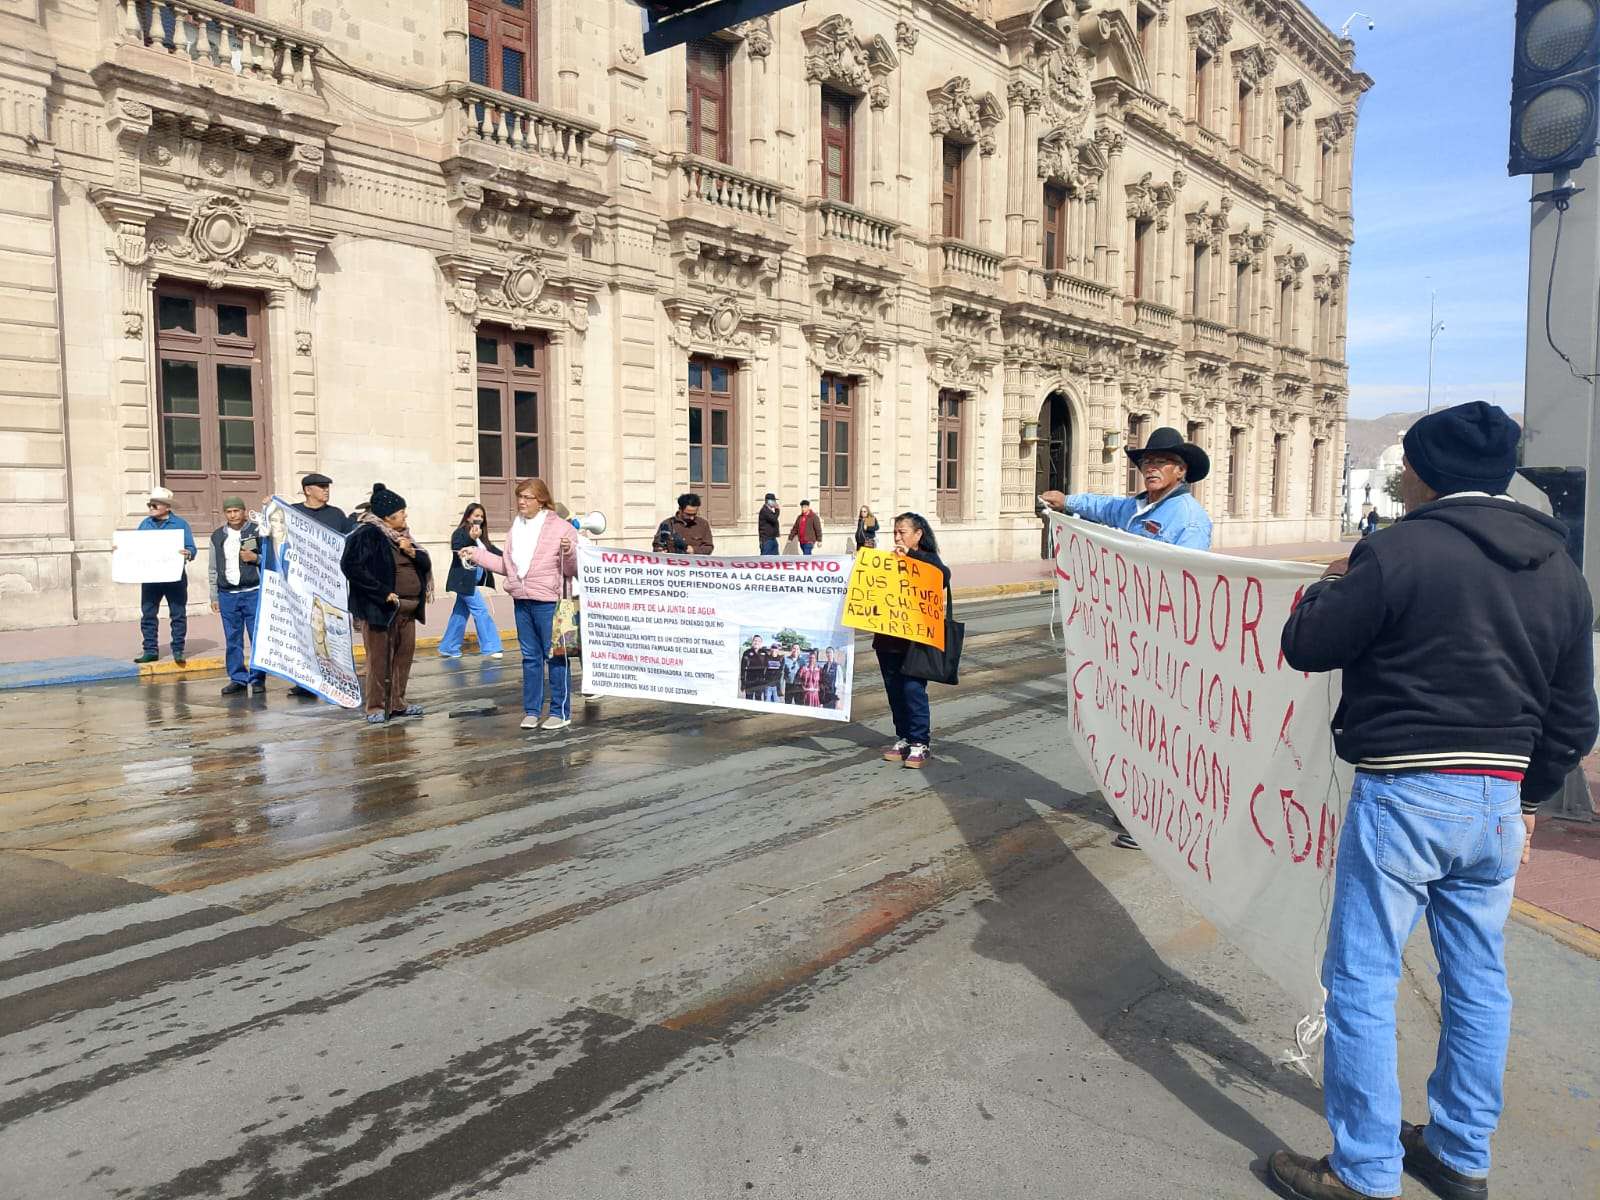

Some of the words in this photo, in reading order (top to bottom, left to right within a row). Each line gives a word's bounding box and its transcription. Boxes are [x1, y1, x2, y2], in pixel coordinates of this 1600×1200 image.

[286, 550, 298, 562] NO
[601, 552, 660, 565] MARU
[667, 557, 690, 566] ES
[696, 559, 724, 568] UN
[731, 560, 841, 572] GOBIERNO
[860, 551, 920, 578] LOERA
[583, 565, 602, 574] QUE
[604, 566, 622, 575] HOY
[625, 567, 643, 575] POR
[646, 568, 663, 576] HOY
[667, 569, 686, 577] NOS
[689, 570, 728, 579] PISOTEA
[755, 573, 786, 582] CLASE
[788, 575, 814, 583] BAJA
[856, 570, 887, 588] TUS
[584, 576, 600, 584] LOS
[603, 577, 665, 587] LADRILLEROS
[667, 580, 741, 591] QUERIENDONOS
[744, 583, 804, 593] ARREBATAR
[807, 587, 848, 595] NUESTRO
[584, 586, 626, 595] TERRENO
[629, 588, 689, 599] EMPESANDO:
[851, 587, 876, 602] DE
[602, 601, 630, 611] FALOMIR
[632, 602, 646, 612] JEFE
[647, 604, 656, 612] DE
[658, 604, 665, 612] LA
[688, 606, 697, 614] DE
[697, 607, 716, 616] AGUA
[847, 602, 881, 616] AZUL
[889, 609, 909, 621] NO
[865, 618, 935, 638] SIRBEN
[1101, 615, 1119, 668] YA
[1130, 630, 1252, 742] SOLUCION
